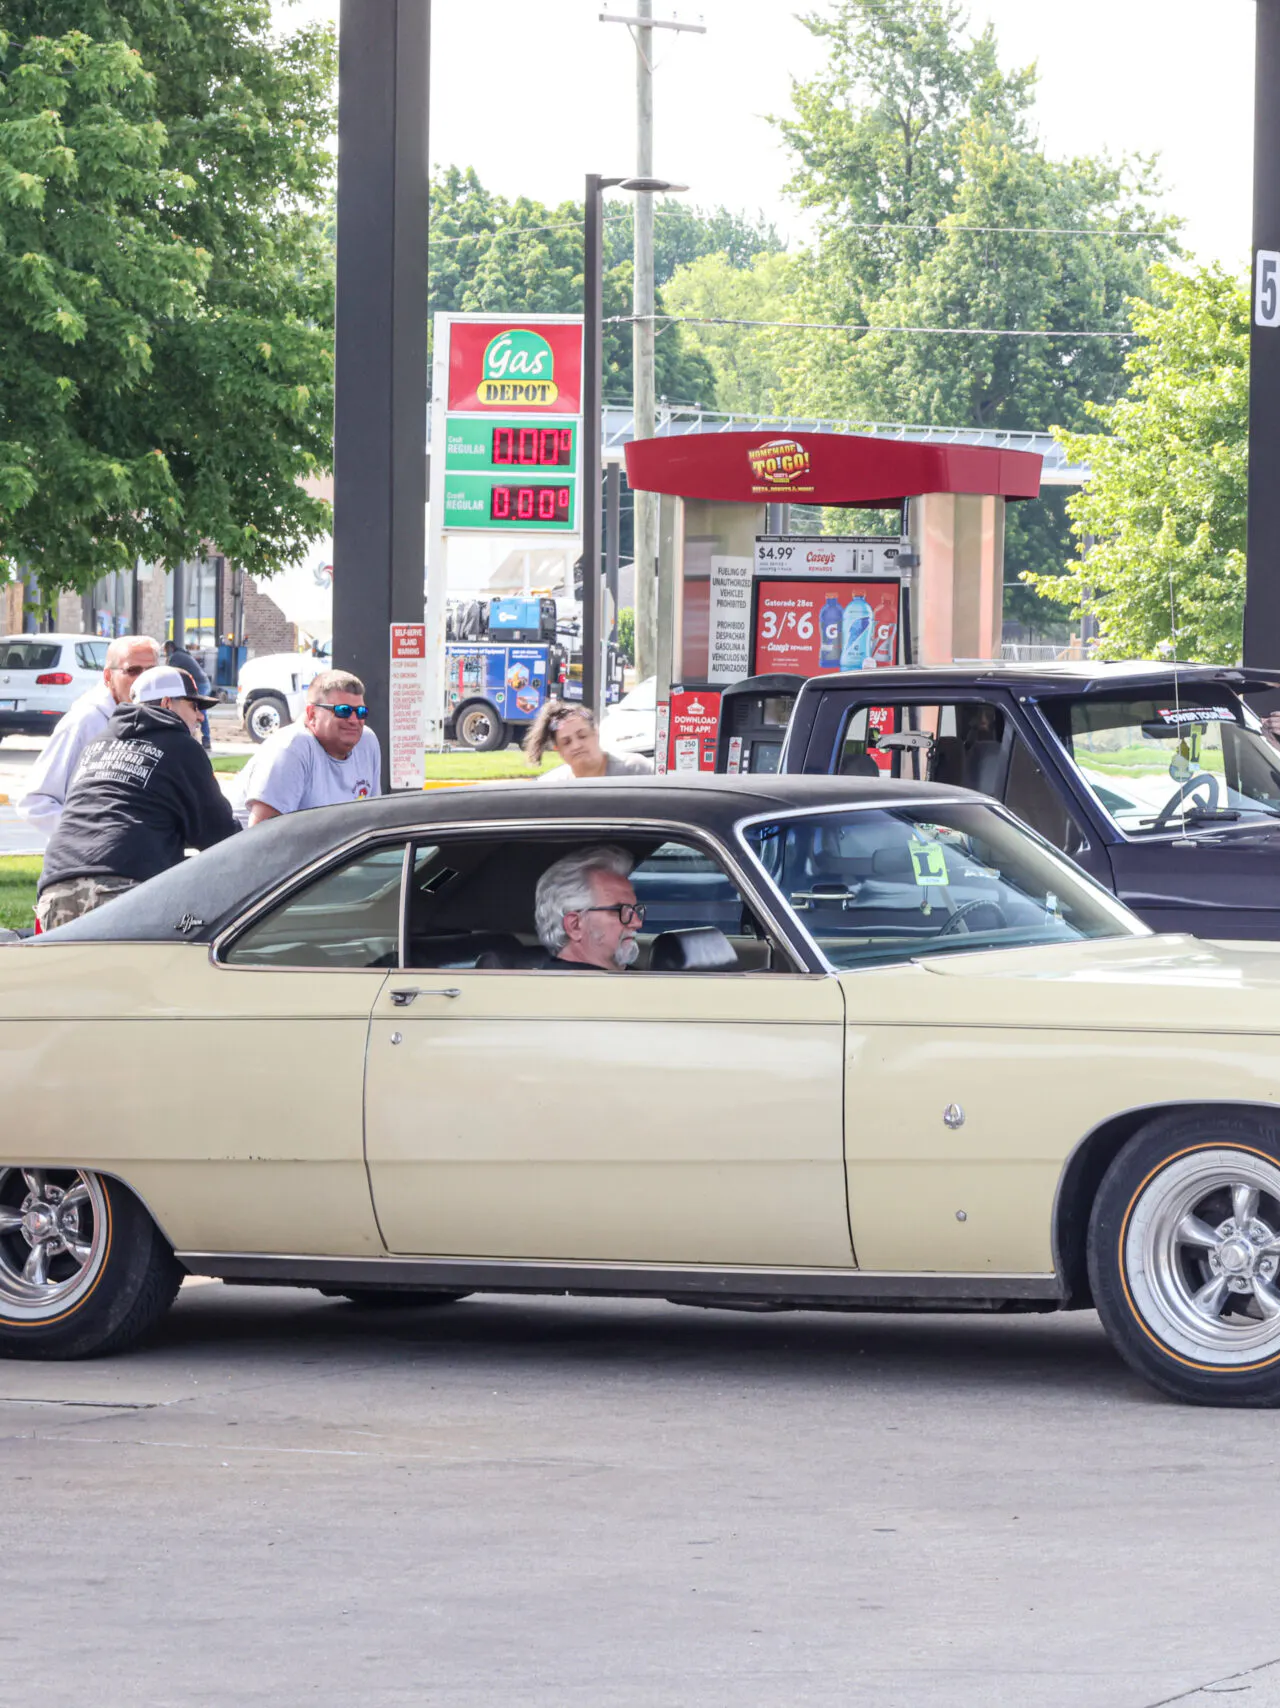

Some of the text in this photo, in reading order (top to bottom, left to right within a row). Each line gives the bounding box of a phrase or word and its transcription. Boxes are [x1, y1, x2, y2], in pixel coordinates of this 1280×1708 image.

[1261, 260, 1278, 320] 5
[488, 334, 549, 379] Gas
[486, 384, 550, 402] DEPOT
[447, 444, 485, 455] REGULAR
[748, 444, 796, 459] HOMEMADE
[446, 500, 484, 510] REGULAR
[806, 551, 836, 565] Casey's
[718, 568, 747, 576] FUELING OF
[712, 578, 752, 587] UNAUTHORIZED
[720, 589, 744, 597] VEHICLES
[716, 600, 747, 608] PROHIBITED
[764, 599, 813, 607] Gatorade 28oz
[716, 621, 745, 629] PROHIBIDO
[761, 611, 814, 639] 3/$6
[395, 629, 423, 637] SELF-SERVE
[715, 632, 745, 640] DESPACHAR
[826, 624, 838, 638] G
[877, 624, 889, 639] G
[400, 638, 417, 646] ISLAND
[715, 642, 741, 651] GASOLINA
[767, 642, 789, 652] Casey's
[712, 653, 748, 662] VEHICULOS NO
[712, 664, 747, 672] AUTORIZADOS
[674, 716, 717, 724] DOWNLOAD
[869, 708, 888, 724] ey's
[1163, 711, 1221, 724] POWER TOUR
[680, 725, 711, 733] THE APP!
[109, 740, 137, 750] FREE
[141, 744, 163, 760] 1903
[101, 751, 145, 766] HARTFORD
[913, 852, 943, 877] L
